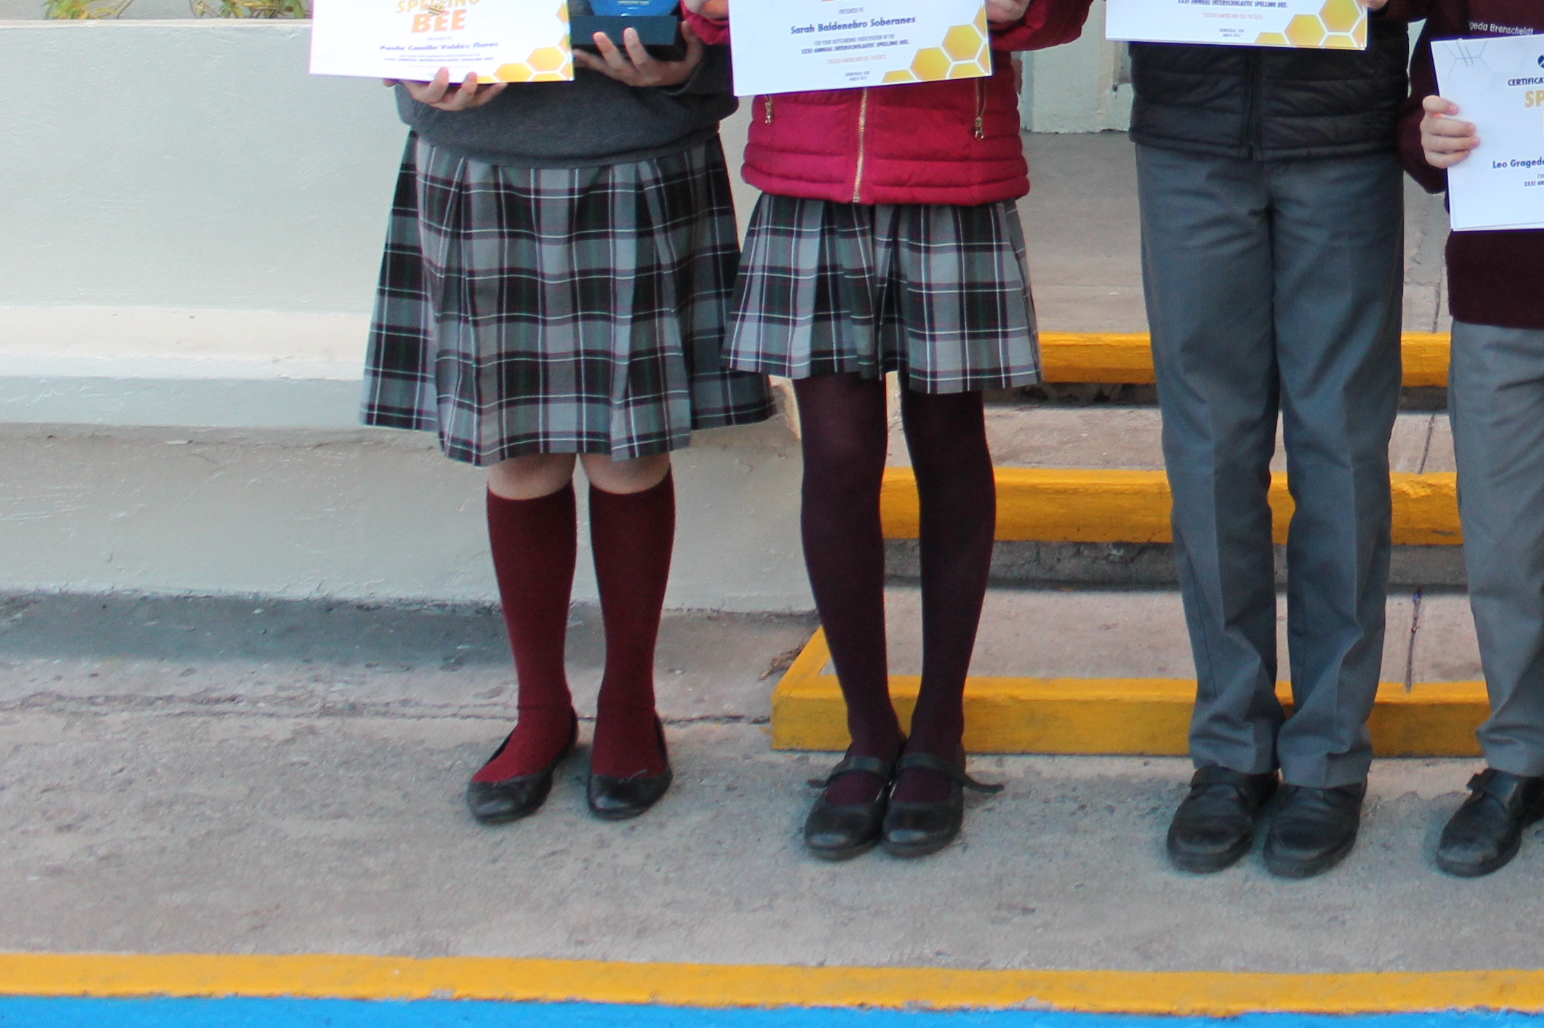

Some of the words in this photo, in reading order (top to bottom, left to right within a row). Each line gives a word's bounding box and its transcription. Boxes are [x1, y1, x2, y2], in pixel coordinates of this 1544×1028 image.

[411, 9, 466, 33] BEE
[791, 25, 815, 34] Sarah
[818, 20, 867, 31] Baldenebro
[870, 17, 915, 27] Soberanes
[1493, 161, 1507, 169] Leo
